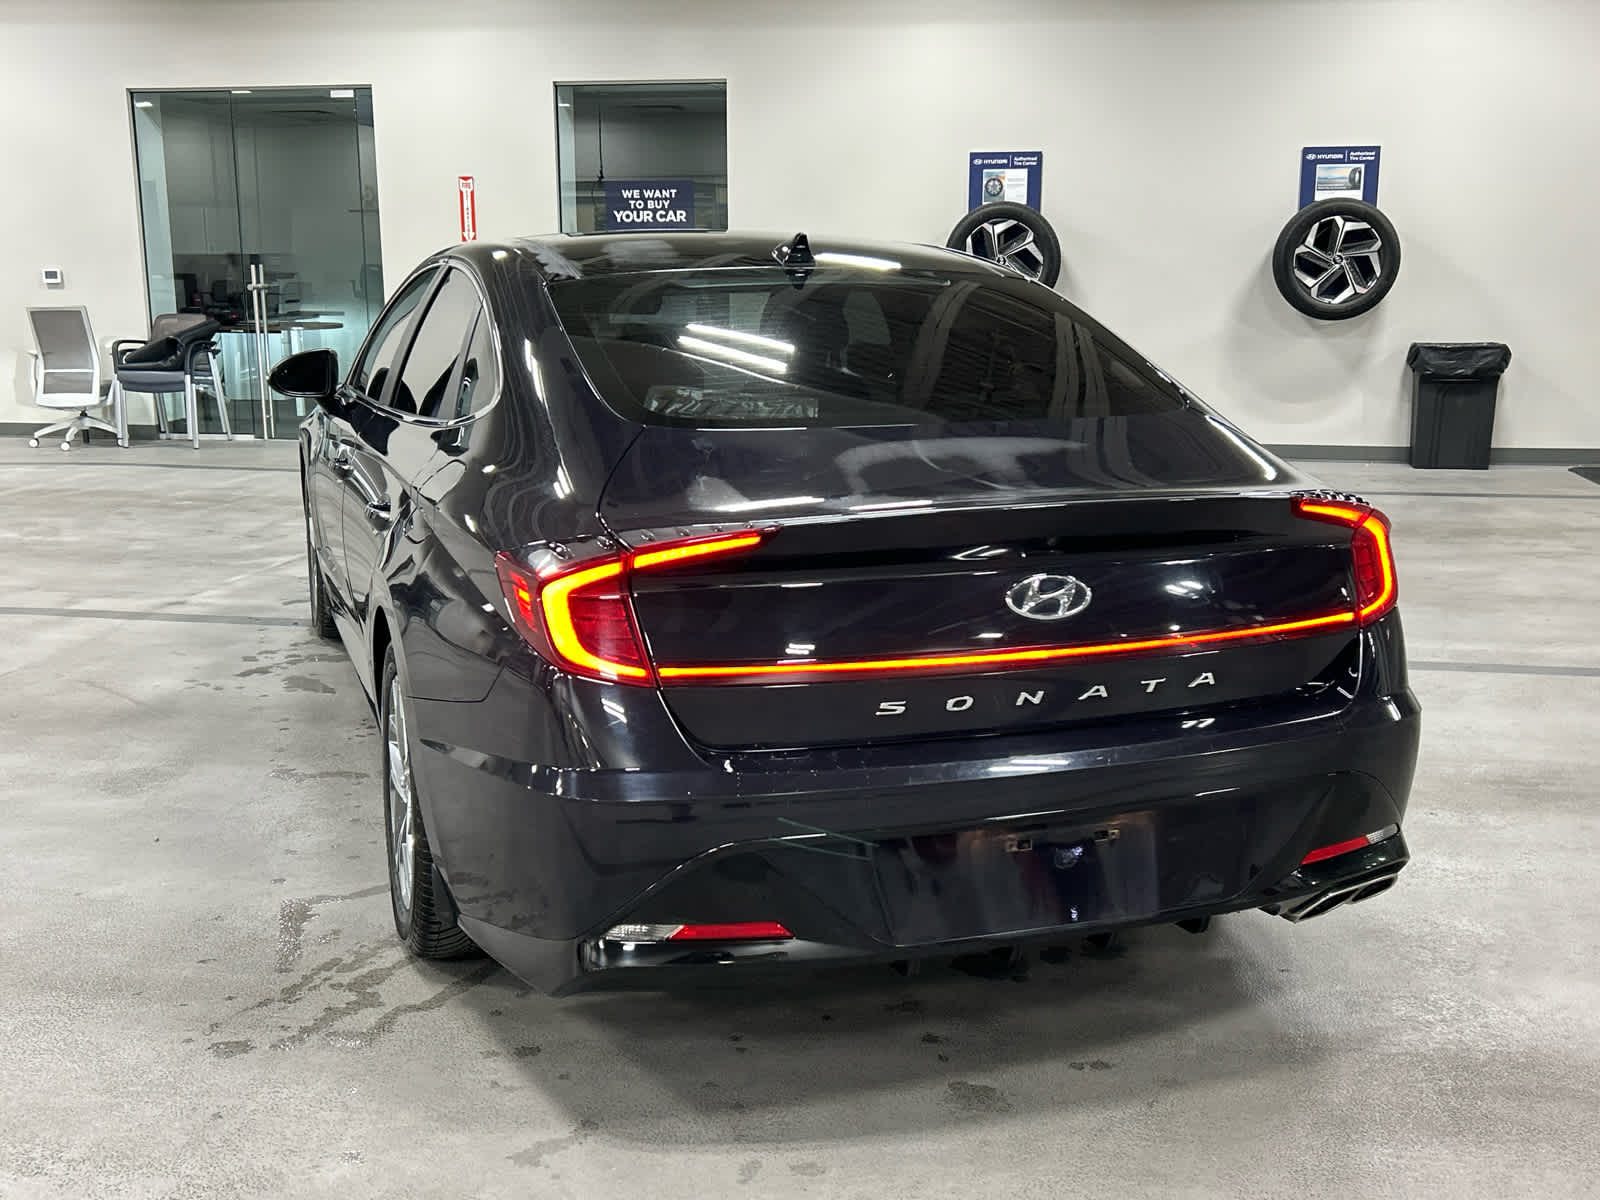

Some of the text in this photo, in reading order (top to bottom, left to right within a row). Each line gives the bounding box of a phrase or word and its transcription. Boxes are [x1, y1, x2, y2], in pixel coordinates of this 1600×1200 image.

[621, 189, 677, 199] WE WANT
[628, 199, 670, 209] TO BUY
[613, 210, 687, 223] YOUR CAR
[875, 672, 1215, 716] SONATA
